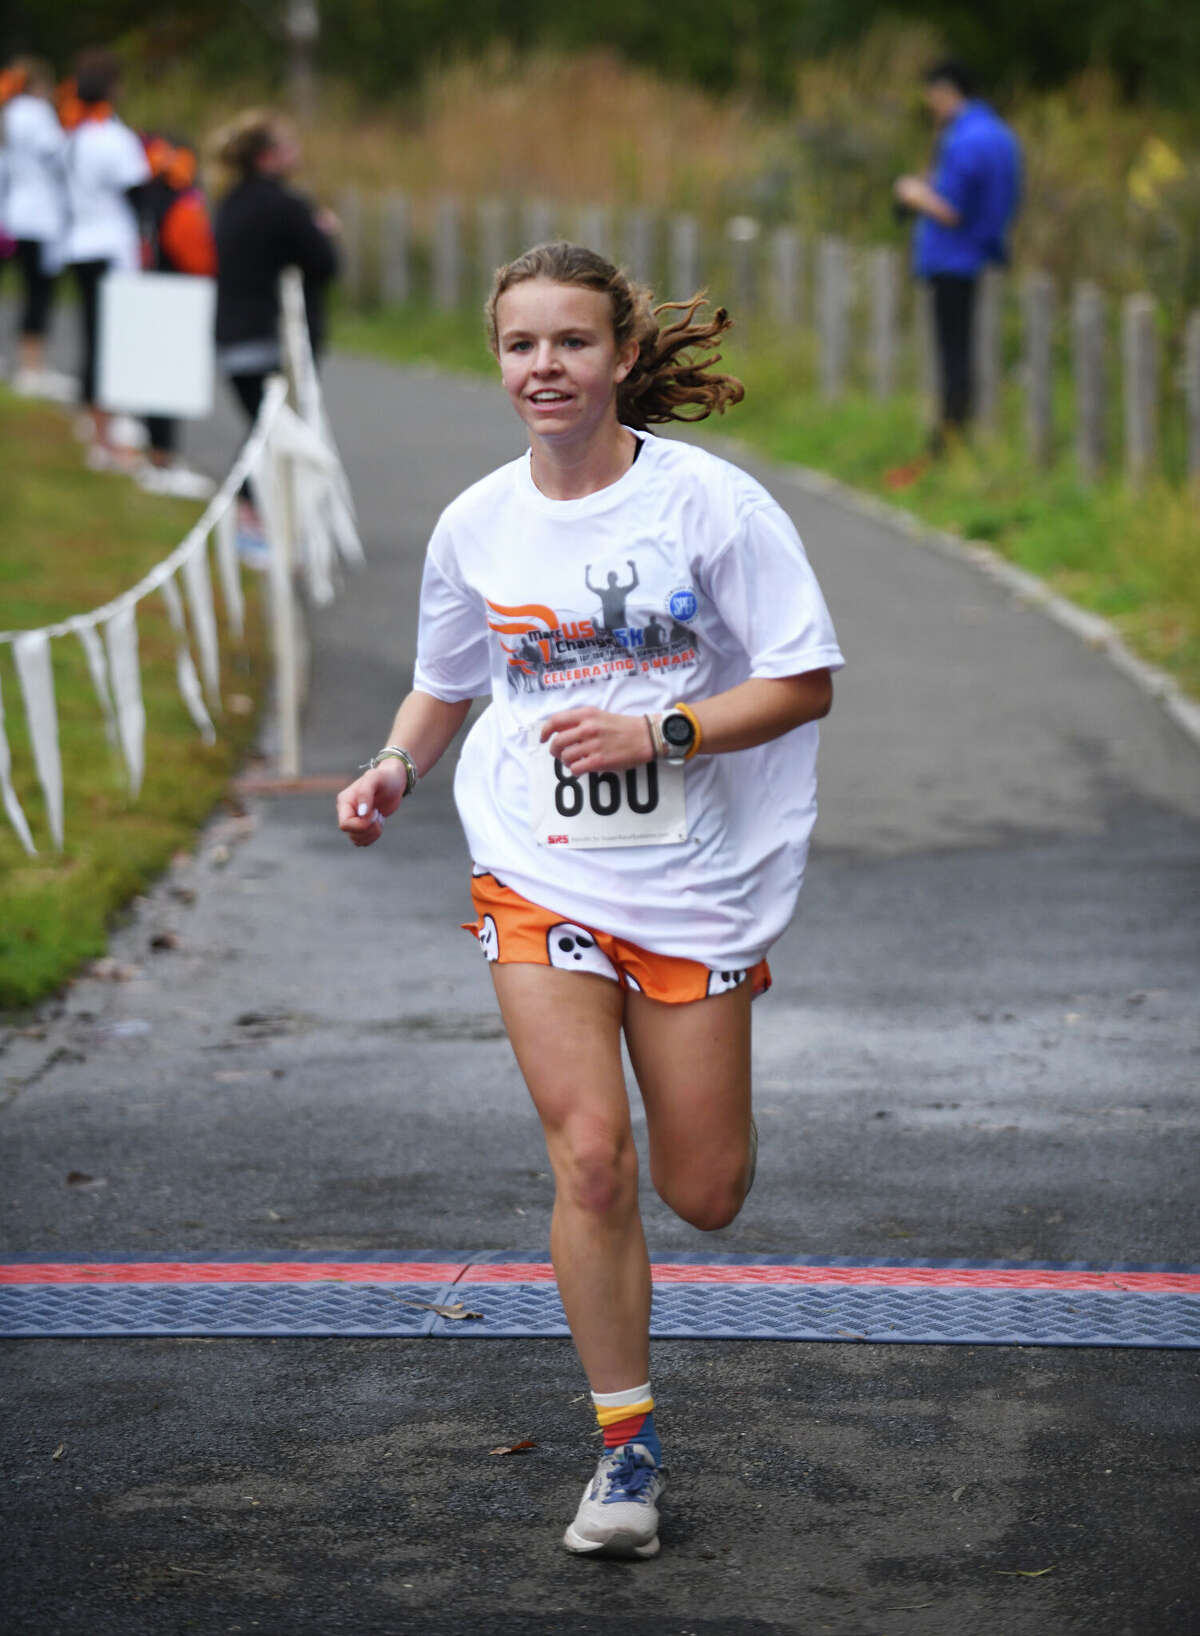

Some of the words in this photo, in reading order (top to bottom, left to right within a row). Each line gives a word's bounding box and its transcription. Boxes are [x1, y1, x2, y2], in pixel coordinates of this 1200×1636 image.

[556, 636, 614, 653] Change
[613, 626, 645, 648] 5K
[543, 659, 635, 684] CELEBRATING
[554, 756, 660, 818] 860
